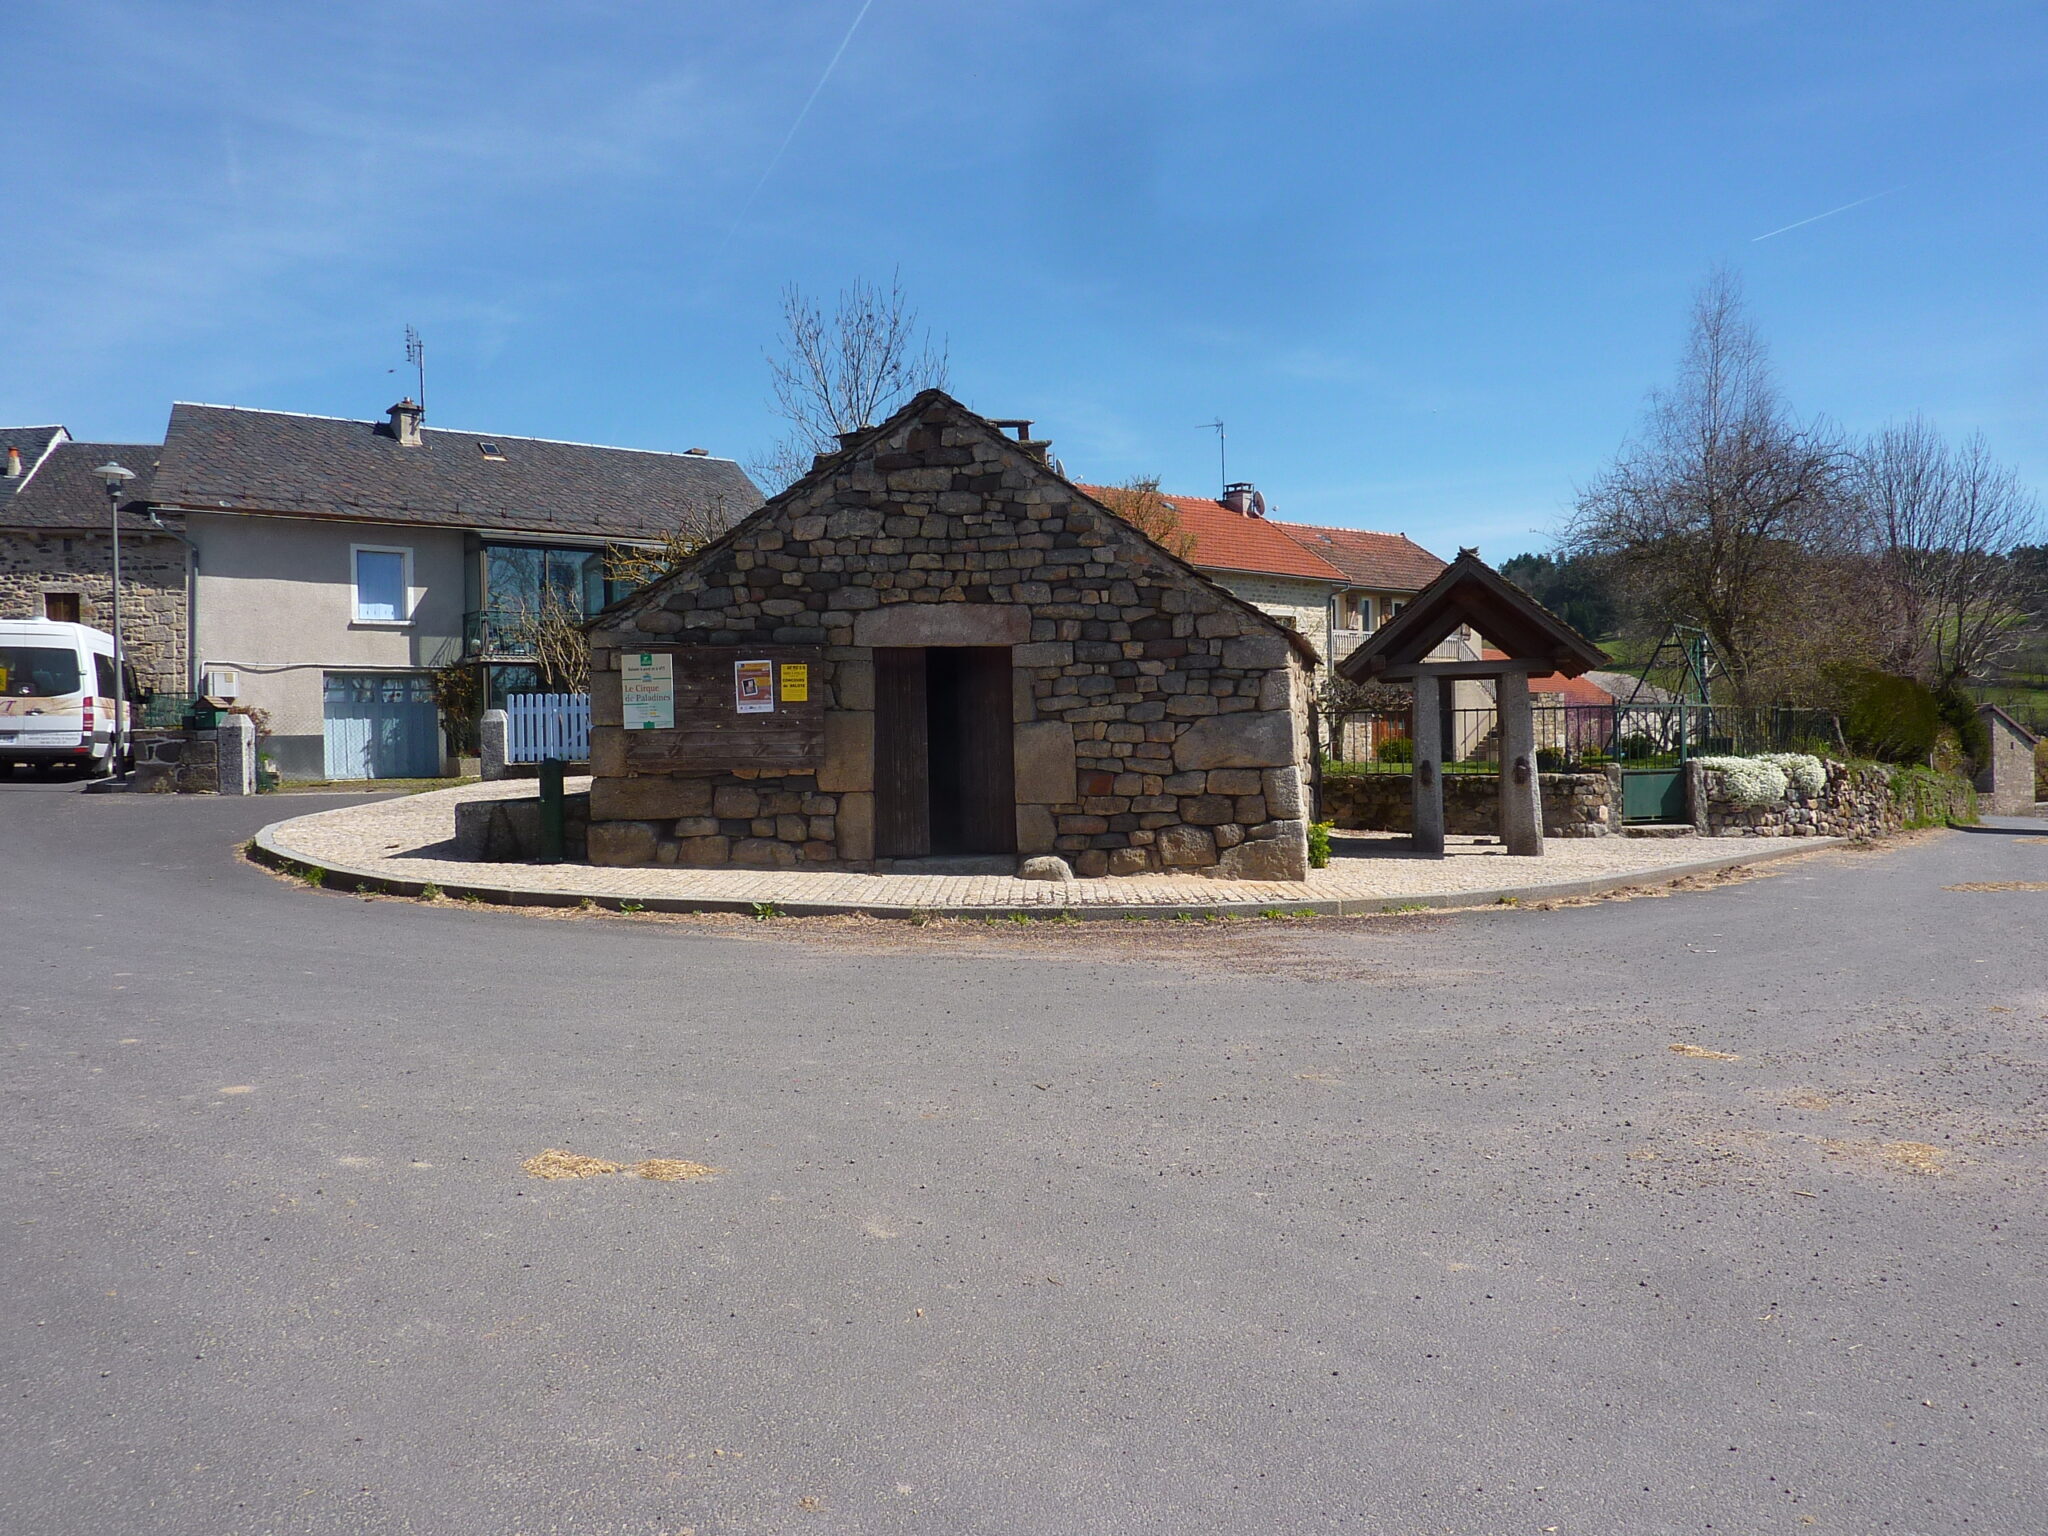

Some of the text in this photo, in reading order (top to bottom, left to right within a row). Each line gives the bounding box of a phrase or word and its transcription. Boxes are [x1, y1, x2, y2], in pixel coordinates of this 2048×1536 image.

[636, 685, 659, 693] Cirque
[625, 693, 671, 702] de Paladines
